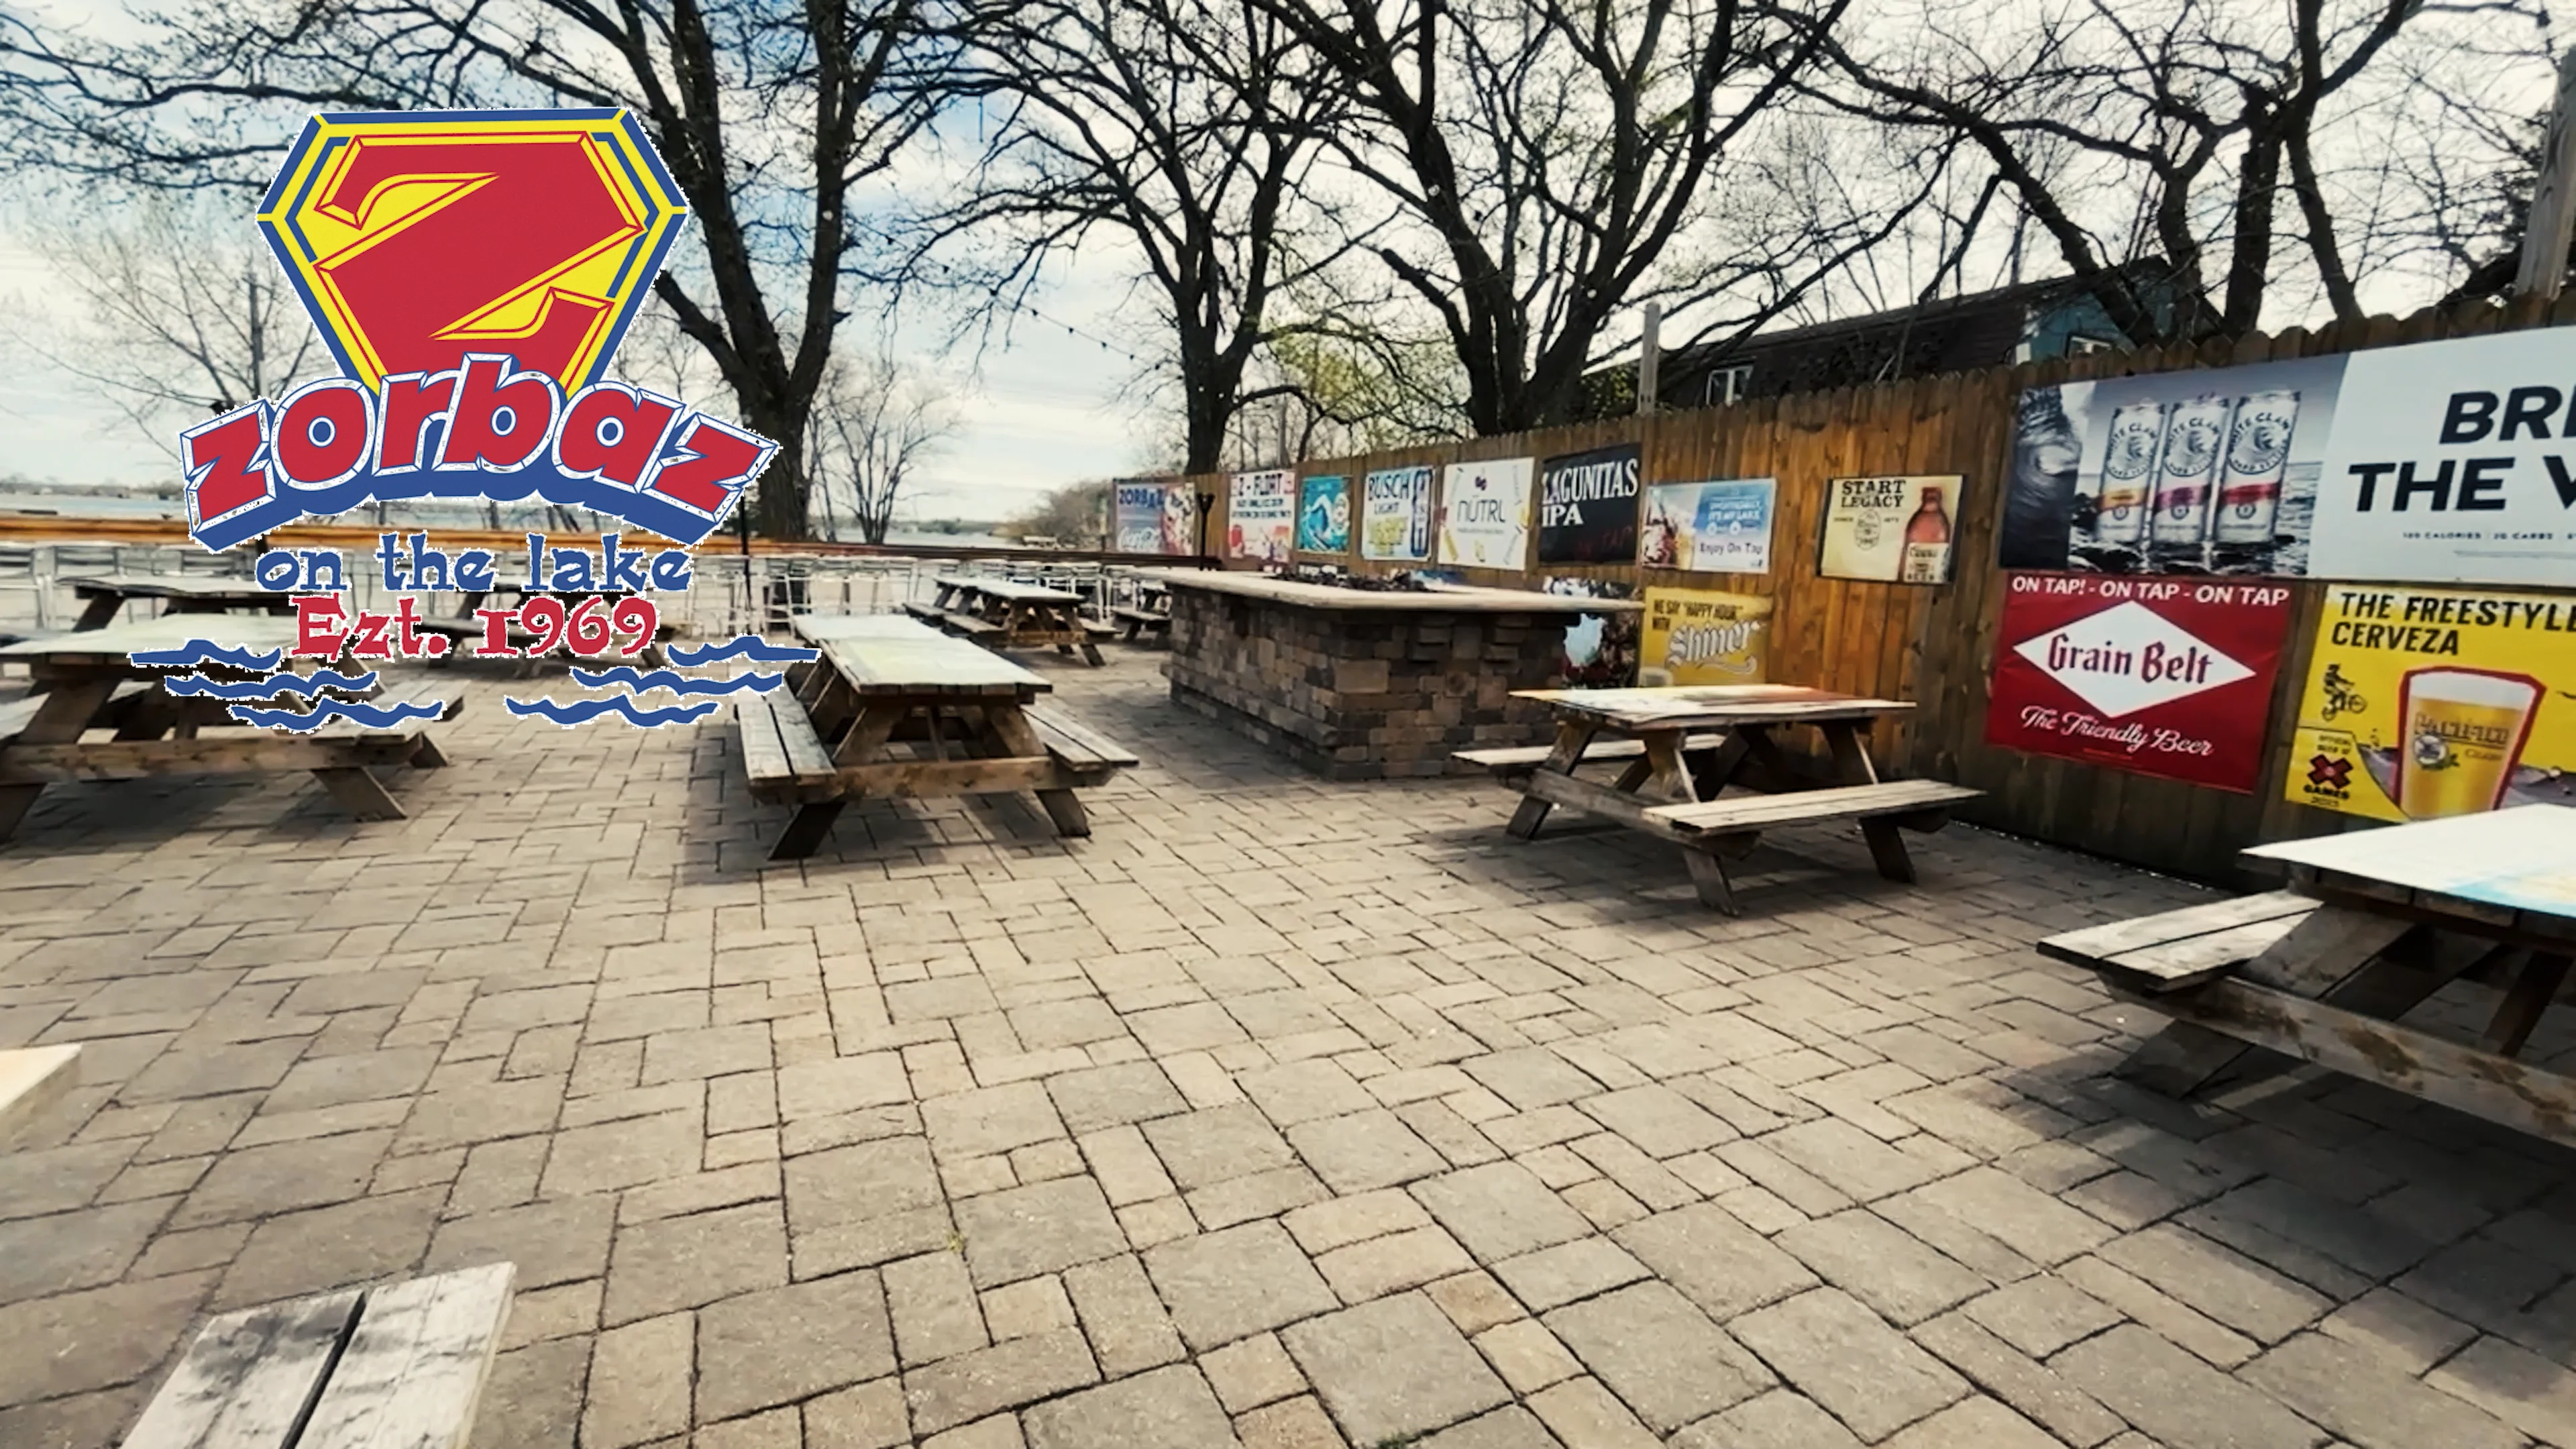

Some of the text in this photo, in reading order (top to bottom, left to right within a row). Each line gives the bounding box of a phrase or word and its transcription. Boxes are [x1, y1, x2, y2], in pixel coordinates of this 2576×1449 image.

[2439, 384, 2576, 445] BR
[1368, 473, 1409, 501] BUSCH
[1542, 458, 1638, 504] LAGUNITAS
[1842, 479, 1907, 495] START
[2348, 457, 2516, 512] THE
[1542, 503, 1584, 527] IPA
[1841, 495, 1904, 508] LEGACY
[2012, 576, 2039, 593] ON
[2044, 577, 2088, 595] TAP!
[2100, 581, 2132, 598] ON
[2137, 582, 2180, 601] TAP
[2195, 586, 2235, 604] ON
[2240, 588, 2290, 606] TAP
[2341, 593, 2396, 619] THE
[1665, 621, 1761, 668] Shiner
[2331, 622, 2459, 656] CERVEZA
[2047, 632, 2214, 685] Grain Belt
[2021, 705, 2058, 731] The
[2061, 711, 2149, 753] Friendly
[2149, 727, 2214, 757] Beer
[2303, 784, 2350, 800] GAMES
